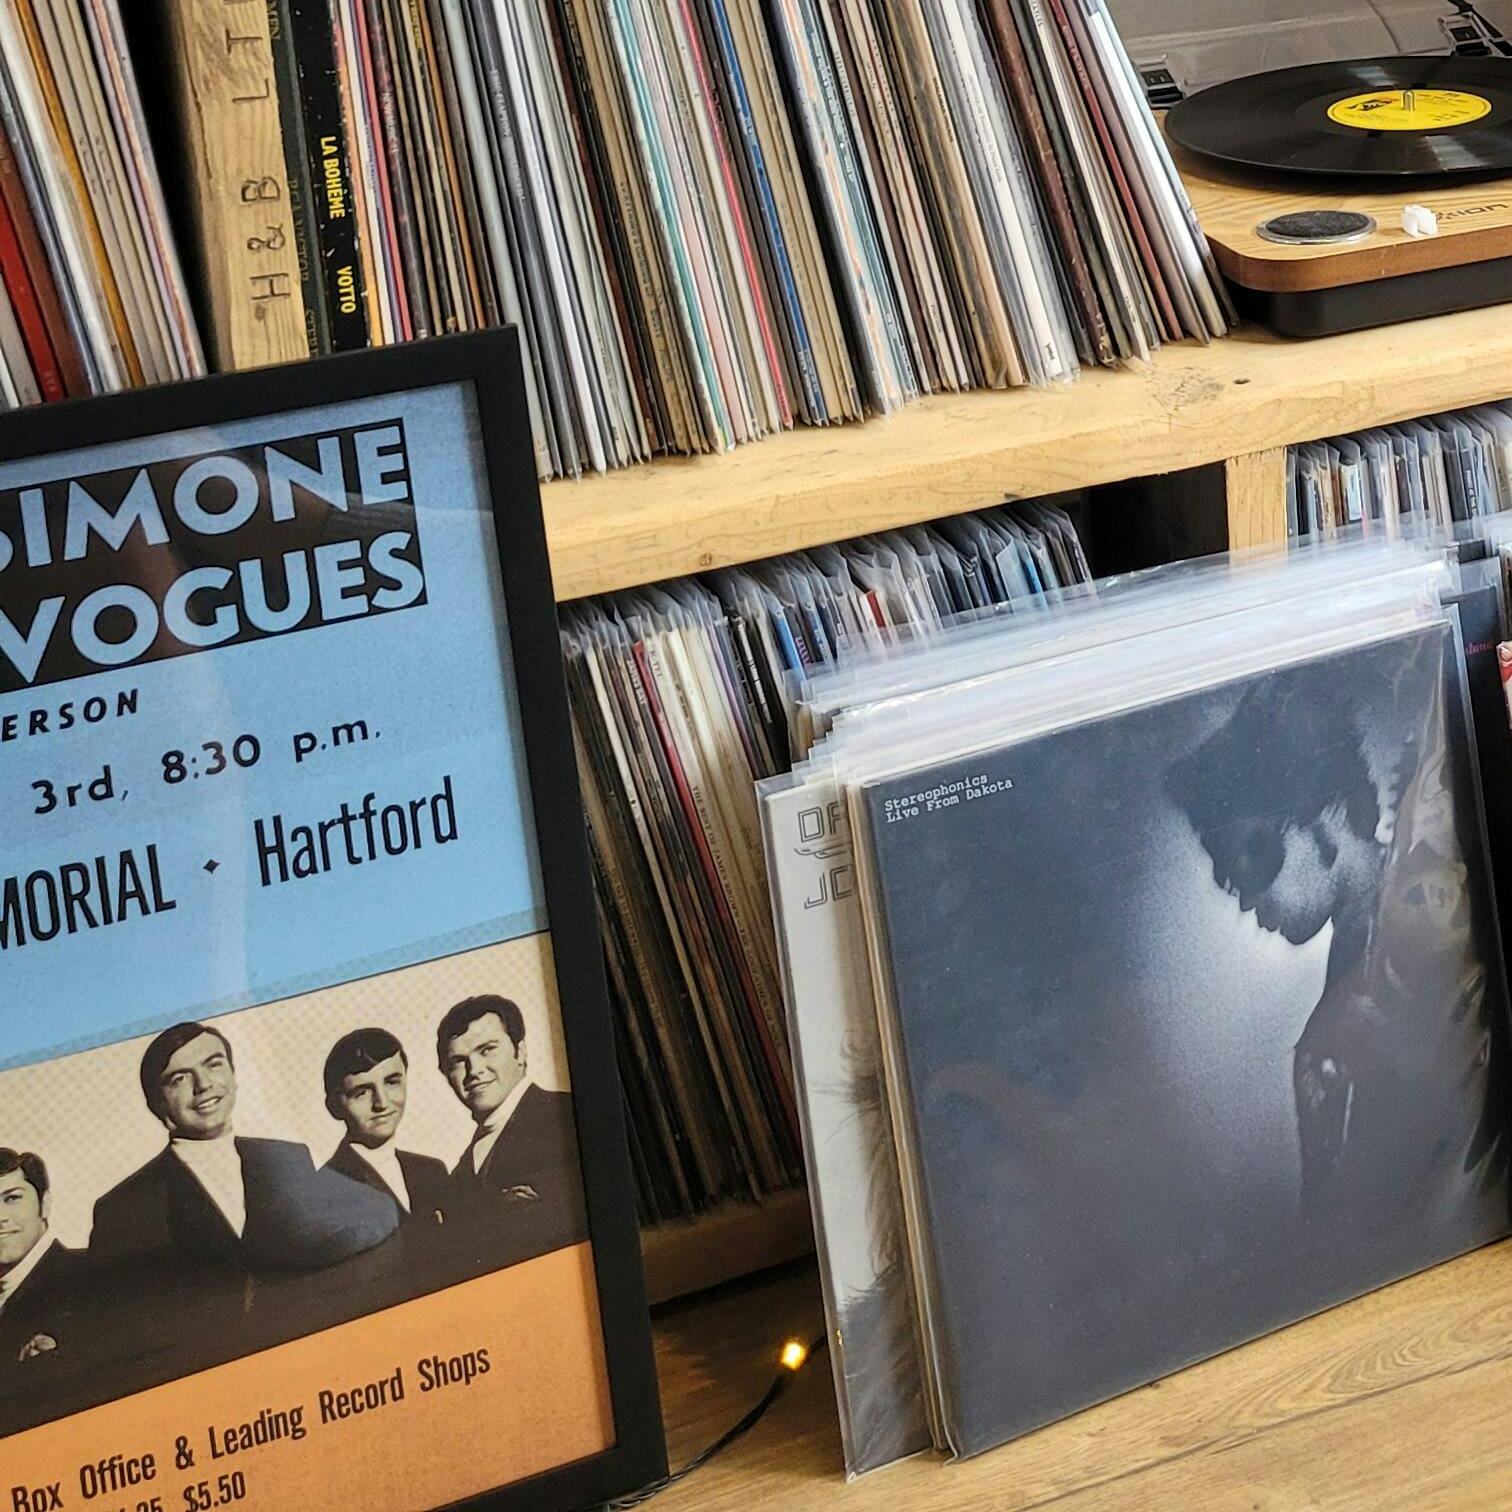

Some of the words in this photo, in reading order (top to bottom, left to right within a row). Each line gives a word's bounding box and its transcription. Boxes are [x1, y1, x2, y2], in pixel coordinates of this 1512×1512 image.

[320, 136, 337, 159] LA
[323, 159, 345, 219] BOHÈME
[336, 265, 357, 315] VOTTO
[0, 421, 409, 574] IMONE
[0, 530, 426, 685] VOGUES
[161, 732, 261, 786] 8:30
[293, 718, 382, 763] p.m.
[884, 773, 988, 813] Stereophonics
[885, 806, 920, 824] Live
[927, 794, 960, 813] From
[965, 778, 1014, 802] Dakota
[254, 775, 459, 887] Hartford
[691, 786, 703, 807] THE
[699, 807, 712, 833] BEST
[711, 845, 729, 880] JAMES
[723, 880, 740, 919] BROWN
[11, 1481, 64, 1512] Box
[79, 1453, 157, 1500] Office
[174, 1435, 196, 1471] &
[208, 1404, 307, 1460] Leading
[318, 1368, 405, 1425] Record
[417, 1348, 492, 1394] Shops
[183, 1470, 247, 1512] $5.50
